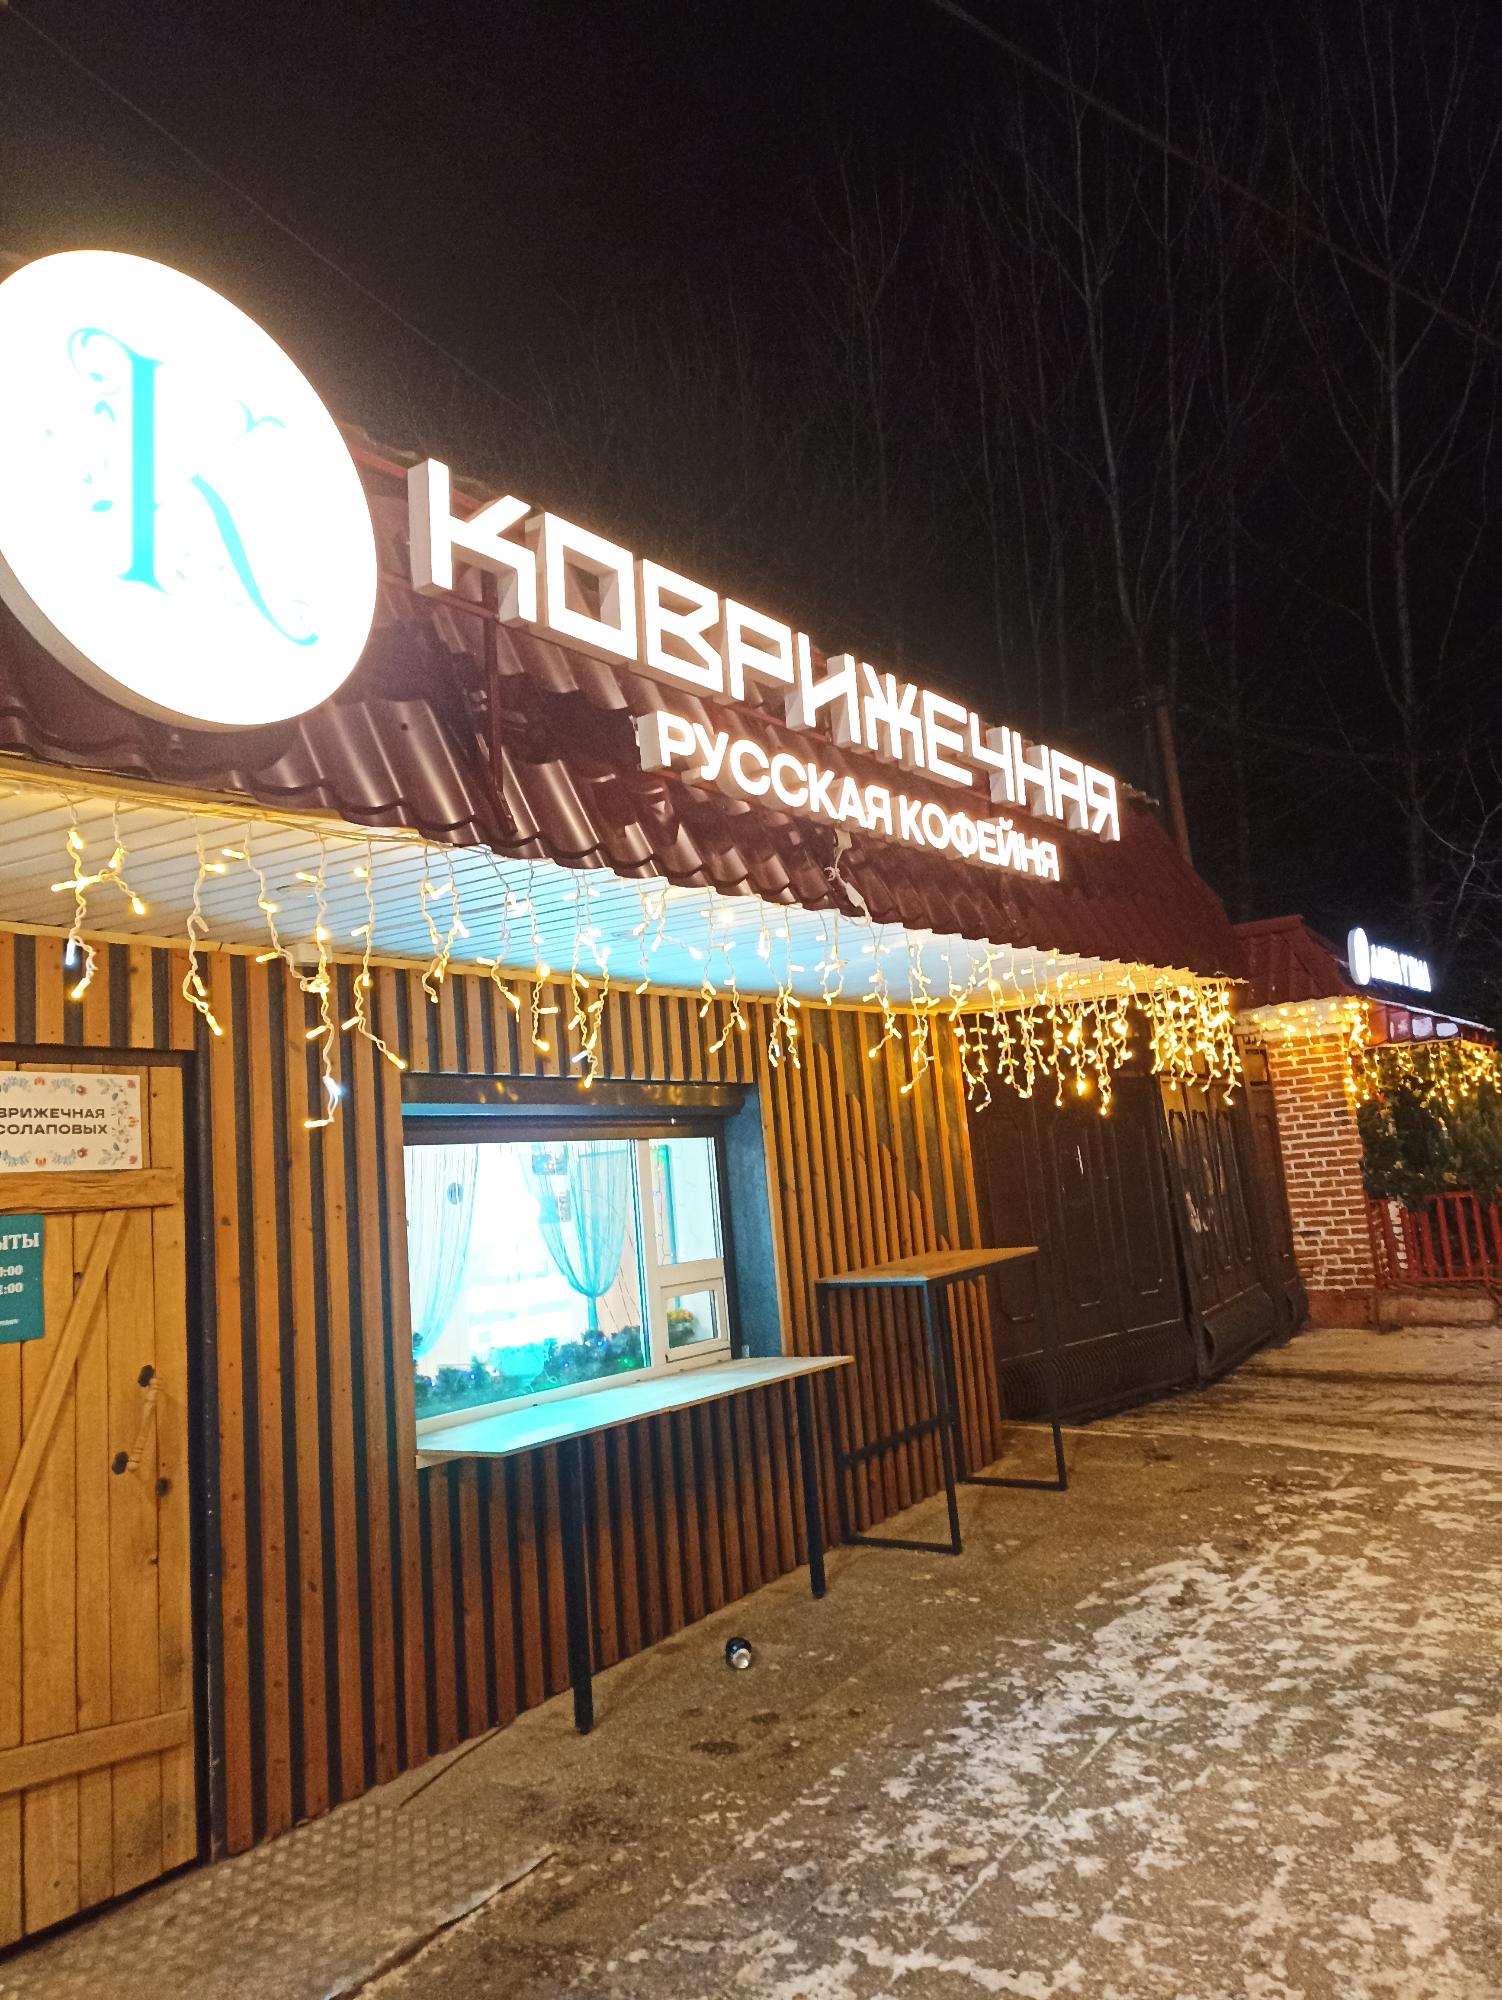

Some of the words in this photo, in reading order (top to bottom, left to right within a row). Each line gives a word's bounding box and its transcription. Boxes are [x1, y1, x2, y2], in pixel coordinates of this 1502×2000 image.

[424, 456, 1121, 842] КОВРИЖЕЧНАЯ
[655, 709, 893, 836] РУССКАЯ
[898, 794, 1061, 882] КОФЕЙНЯ
